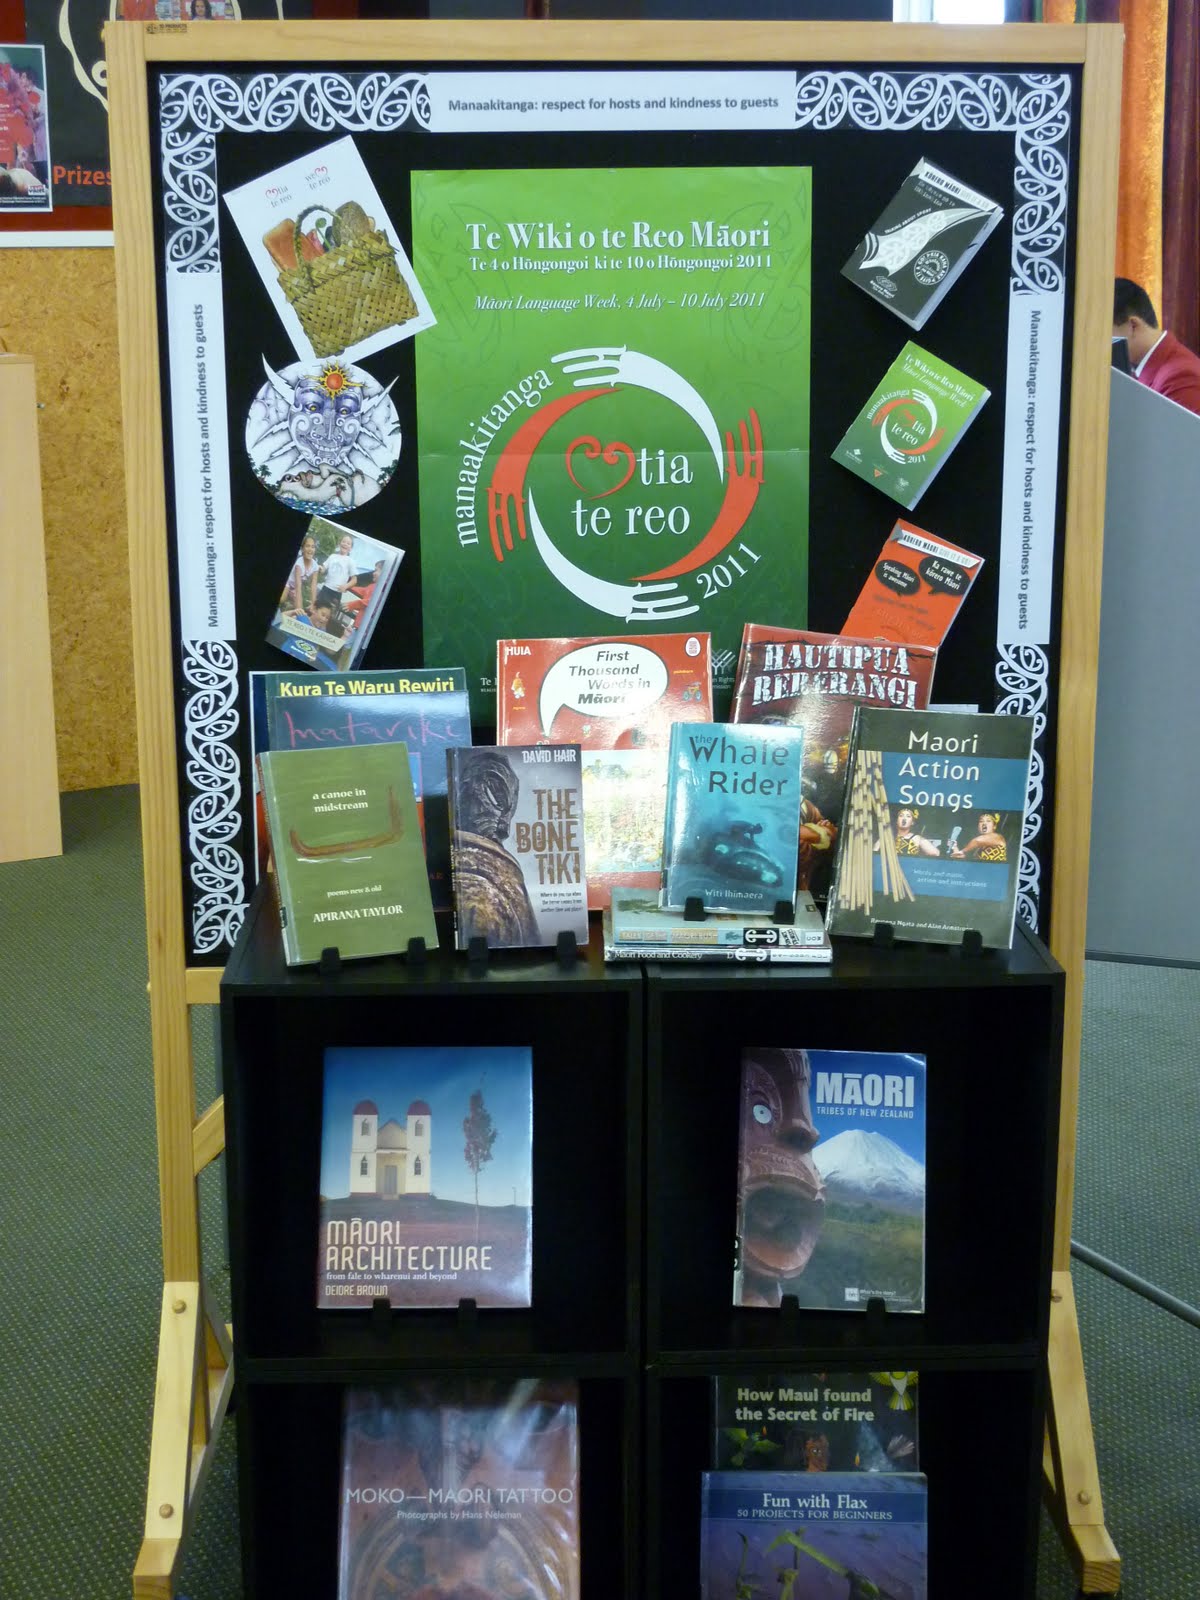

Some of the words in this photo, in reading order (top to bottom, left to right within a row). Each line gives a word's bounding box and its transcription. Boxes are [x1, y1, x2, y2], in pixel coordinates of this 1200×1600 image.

[448, 98, 538, 112] Manaakitanga:
[541, 98, 586, 111] respect
[588, 98, 606, 110] for
[609, 98, 641, 109] hosts
[643, 98, 666, 109] and
[669, 97, 722, 109] kindness
[724, 98, 738, 109] to
[740, 97, 779, 111] guests
[465, 223, 501, 250] Te
[506, 222, 573, 249] Wiki
[579, 231, 595, 249] o
[601, 226, 626, 249] te
[632, 221, 684, 249] Reo
[690, 220, 770, 248] Māori
[469, 256, 487, 271] Te
[489, 257, 498, 271] 4
[501, 261, 510, 271] o
[513, 256, 589, 274] Hōngongoi
[594, 256, 607, 270] ki
[609, 257, 623, 270] te
[626, 256, 644, 269] 10
[646, 260, 655, 269] o
[658, 255, 734, 273] Hōngongoi
[736, 254, 772, 269] 2011
[474, 295, 513, 310] Māori
[516, 295, 580, 312] Language
[583, 294, 621, 310] Week,
[625, 294, 634, 308] 4
[636, 293, 665, 311] July
[680, 293, 696, 308] 10
[698, 293, 727, 311] July
[729, 292, 765, 307] 2011
[195, 303, 205, 343] guests
[196, 346, 205, 359] to
[1026, 310, 1041, 399] Manaakitanga:
[197, 362, 208, 415] kindness
[866, 389, 910, 420] manaakitanga
[199, 417, 210, 439] and
[911, 420, 925, 435] tia
[1025, 401, 1036, 444] respect
[891, 422, 902, 435] te
[902, 431, 918, 446] reo
[201, 442, 211, 474] hosts
[454, 368, 554, 548] manaakitanga
[907, 454, 926, 464] 2011
[1025, 446, 1036, 464] for
[636, 447, 694, 486] tia
[202, 477, 212, 494] for
[1024, 467, 1035, 499] hosts
[203, 500, 214, 539] respect
[572, 499, 612, 537] te
[625, 505, 690, 536] reo
[1023, 501, 1034, 523] and
[1021, 525, 1032, 576] kindness
[696, 542, 762, 599] 2011
[882, 563, 902, 578] Speaking
[931, 560, 940, 570] Ka
[940, 565, 954, 577] rawe
[206, 542, 219, 628] Manaakitanga:
[888, 574, 908, 588] awesome
[1020, 578, 1029, 591] to
[1018, 593, 1029, 630] guests
[506, 646, 532, 656] HUIA
[597, 650, 630, 662] First
[763, 644, 910, 676] HAUTIPUA
[569, 664, 639, 677] Thousand
[280, 682, 322, 697] Kura
[324, 681, 345, 695] Te
[348, 680, 395, 695] Waru
[399, 677, 455, 693] Rewiri
[588, 678, 634, 690] Words
[638, 678, 650, 690] in
[752, 672, 918, 710] RERERANGI
[578, 693, 626, 705] Māori
[284, 705, 460, 748] matariki
[695, 735, 712, 744] the
[908, 730, 978, 754] Maori
[522, 750, 551, 763] DAVID
[554, 750, 577, 763] HAIR
[689, 736, 789, 766] Whale
[898, 757, 980, 781] Action
[709, 771, 788, 795] Rider
[321, 790, 353, 800] canoe
[354, 788, 367, 797] in
[533, 788, 578, 820] THE
[899, 785, 973, 812] Songs
[314, 802, 368, 813] midstream
[515, 821, 580, 853] BONE
[534, 853, 581, 885] TIKI
[327, 890, 349, 898] poems
[705, 889, 723, 898] Witi
[725, 890, 763, 899] Ihimaera
[313, 909, 361, 923] APIRANA
[361, 905, 403, 918] TAYLOR
[672, 952, 702, 960] Cookery
[816, 1072, 915, 1108] MĀORI
[816, 1106, 845, 1116] TRIBES
[847, 1108, 857, 1116] OF
[860, 1108, 877, 1117] NEW
[880, 1109, 914, 1119] ZEALAND
[326, 1218, 400, 1245] MĀORI
[326, 1246, 492, 1271] ARCHITECTURE
[326, 1272, 345, 1280] from
[347, 1272, 361, 1280] fale
[374, 1272, 411, 1280] wharenui
[412, 1272, 427, 1280] and
[429, 1272, 457, 1282] beyond
[325, 1285, 355, 1296] DEIDRE
[356, 1285, 388, 1296] BROWN
[737, 1388, 777, 1402] How
[778, 1388, 819, 1402] Maui
[823, 1388, 872, 1402] found
[735, 1407, 766, 1420] the
[768, 1408, 817, 1421] Secret
[822, 1407, 840, 1421] of
[844, 1408, 874, 1422] Fire
[496, 1487, 573, 1504] TATTOO
[763, 1493, 790, 1508] Fun
[797, 1494, 830, 1508] with
[837, 1494, 868, 1509] Flax
[397, 1510, 448, 1521] Photographs
[450, 1511, 460, 1521] by
[462, 1510, 482, 1519] Hans
[485, 1510, 522, 1519] Neleman
[737, 1509, 748, 1517] 50
[752, 1509, 804, 1519] PROJECTS
[808, 1511, 829, 1519] FOR
[833, 1511, 893, 1520] BEGINNERS
